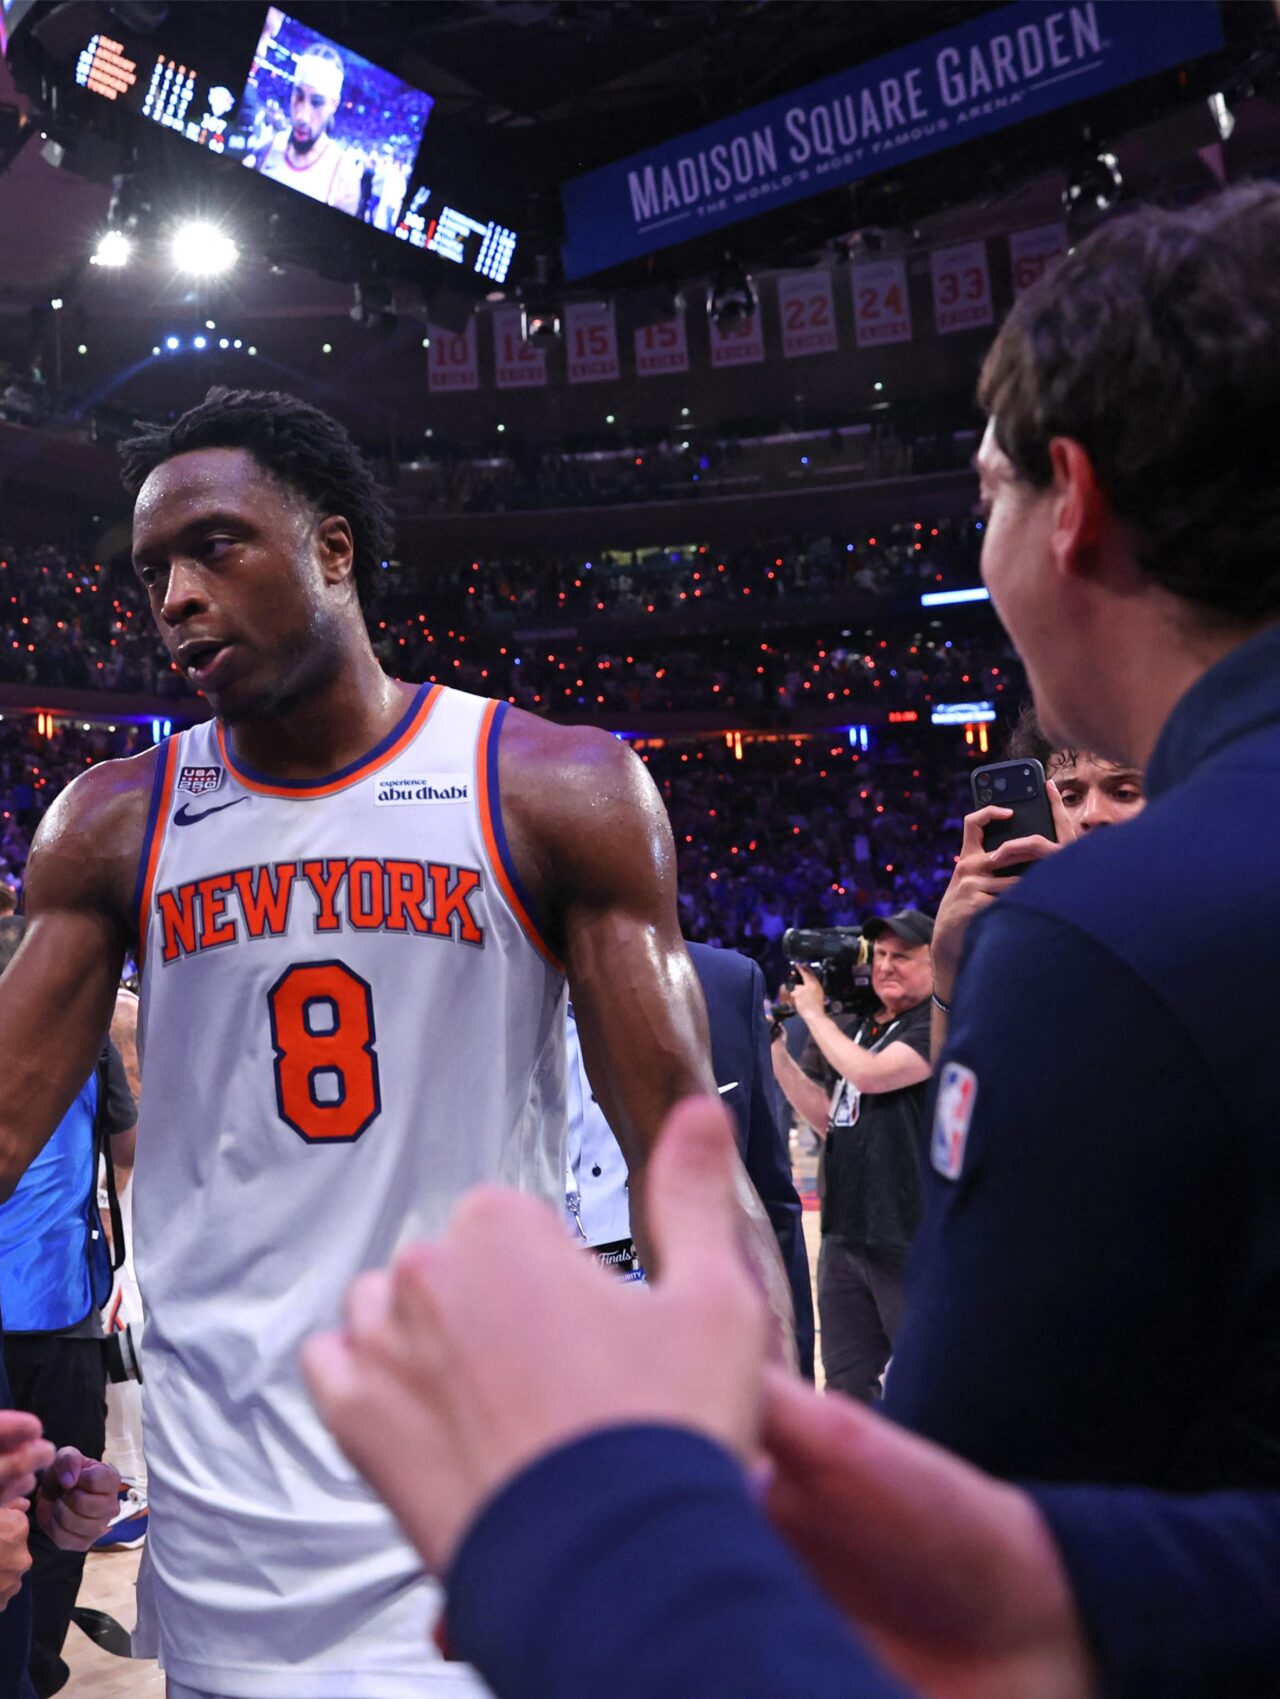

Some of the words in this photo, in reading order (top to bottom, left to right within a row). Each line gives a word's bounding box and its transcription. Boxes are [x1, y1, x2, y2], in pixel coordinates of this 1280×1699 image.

[628, 126, 777, 222] MADISON
[785, 68, 927, 163] SQUARE
[936, 1, 1101, 107] GARDEN
[697, 199, 728, 217] THE
[733, 168, 810, 204] WORLD'S
[815, 147, 865, 175] MOST
[871, 117, 949, 154] FAMOUS
[956, 90, 1023, 124] ARENA
[858, 283, 903, 320] 24
[938, 267, 984, 305] 33
[784, 295, 829, 331] 22
[435, 333, 468, 366] 10
[575, 323, 608, 357] 15
[179, 781, 217, 789] 250
[184, 769, 217, 777] USA
[379, 778, 427, 788] experience
[378, 787, 413, 801] abu
[415, 785, 468, 800] dhabi
[157, 860, 299, 967] NEW
[303, 856, 486, 950] YORK
[267, 958, 382, 1145] 8
[598, 1248, 632, 1269] Finals
